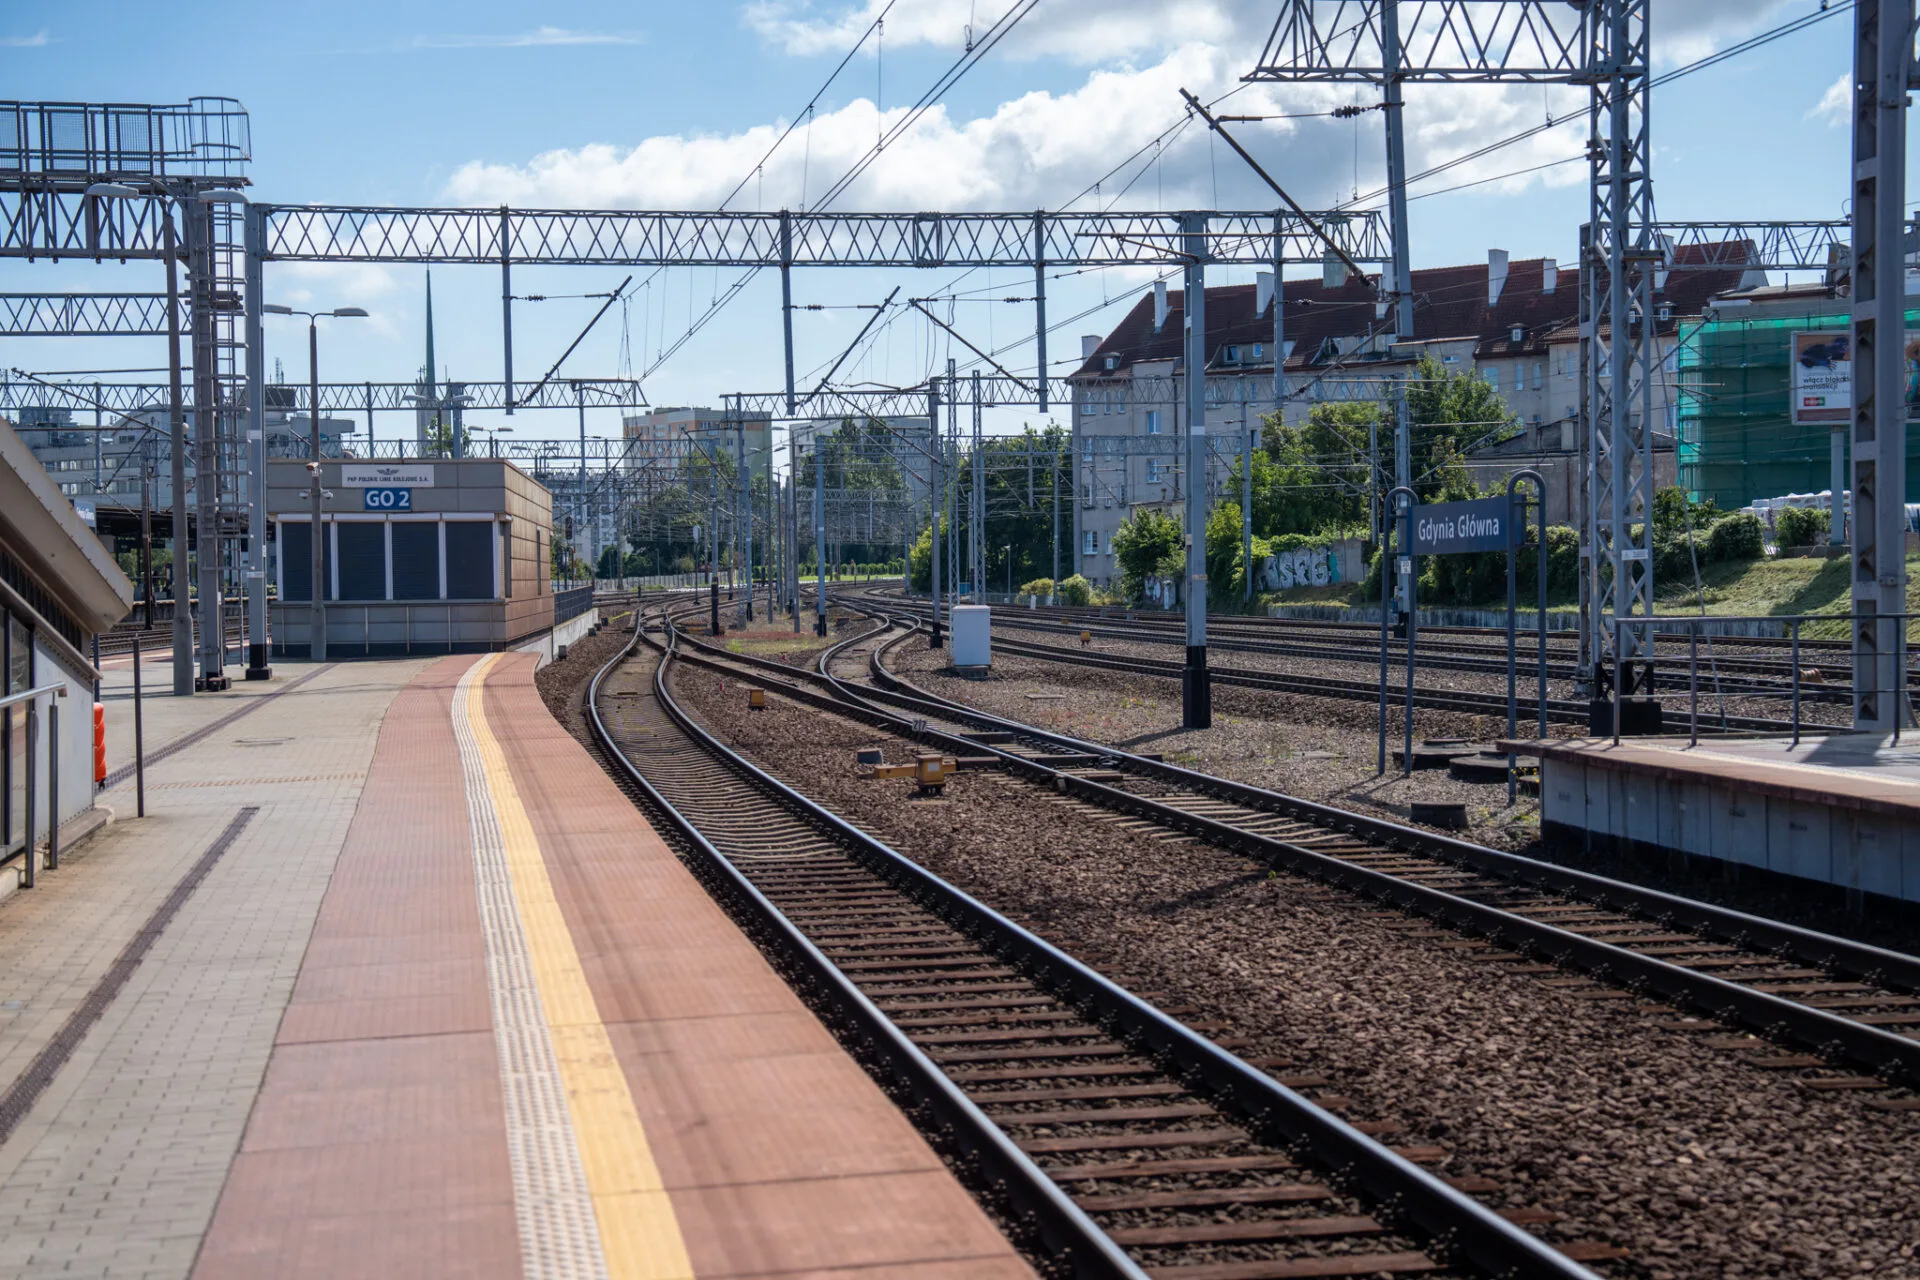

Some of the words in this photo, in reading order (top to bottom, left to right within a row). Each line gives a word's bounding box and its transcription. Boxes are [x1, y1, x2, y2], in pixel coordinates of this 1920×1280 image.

[366, 490, 395, 507] GO
[398, 490, 410, 507] 2
[1418, 517, 1455, 546] Gdynia
[1457, 513, 1500, 538] Główna
